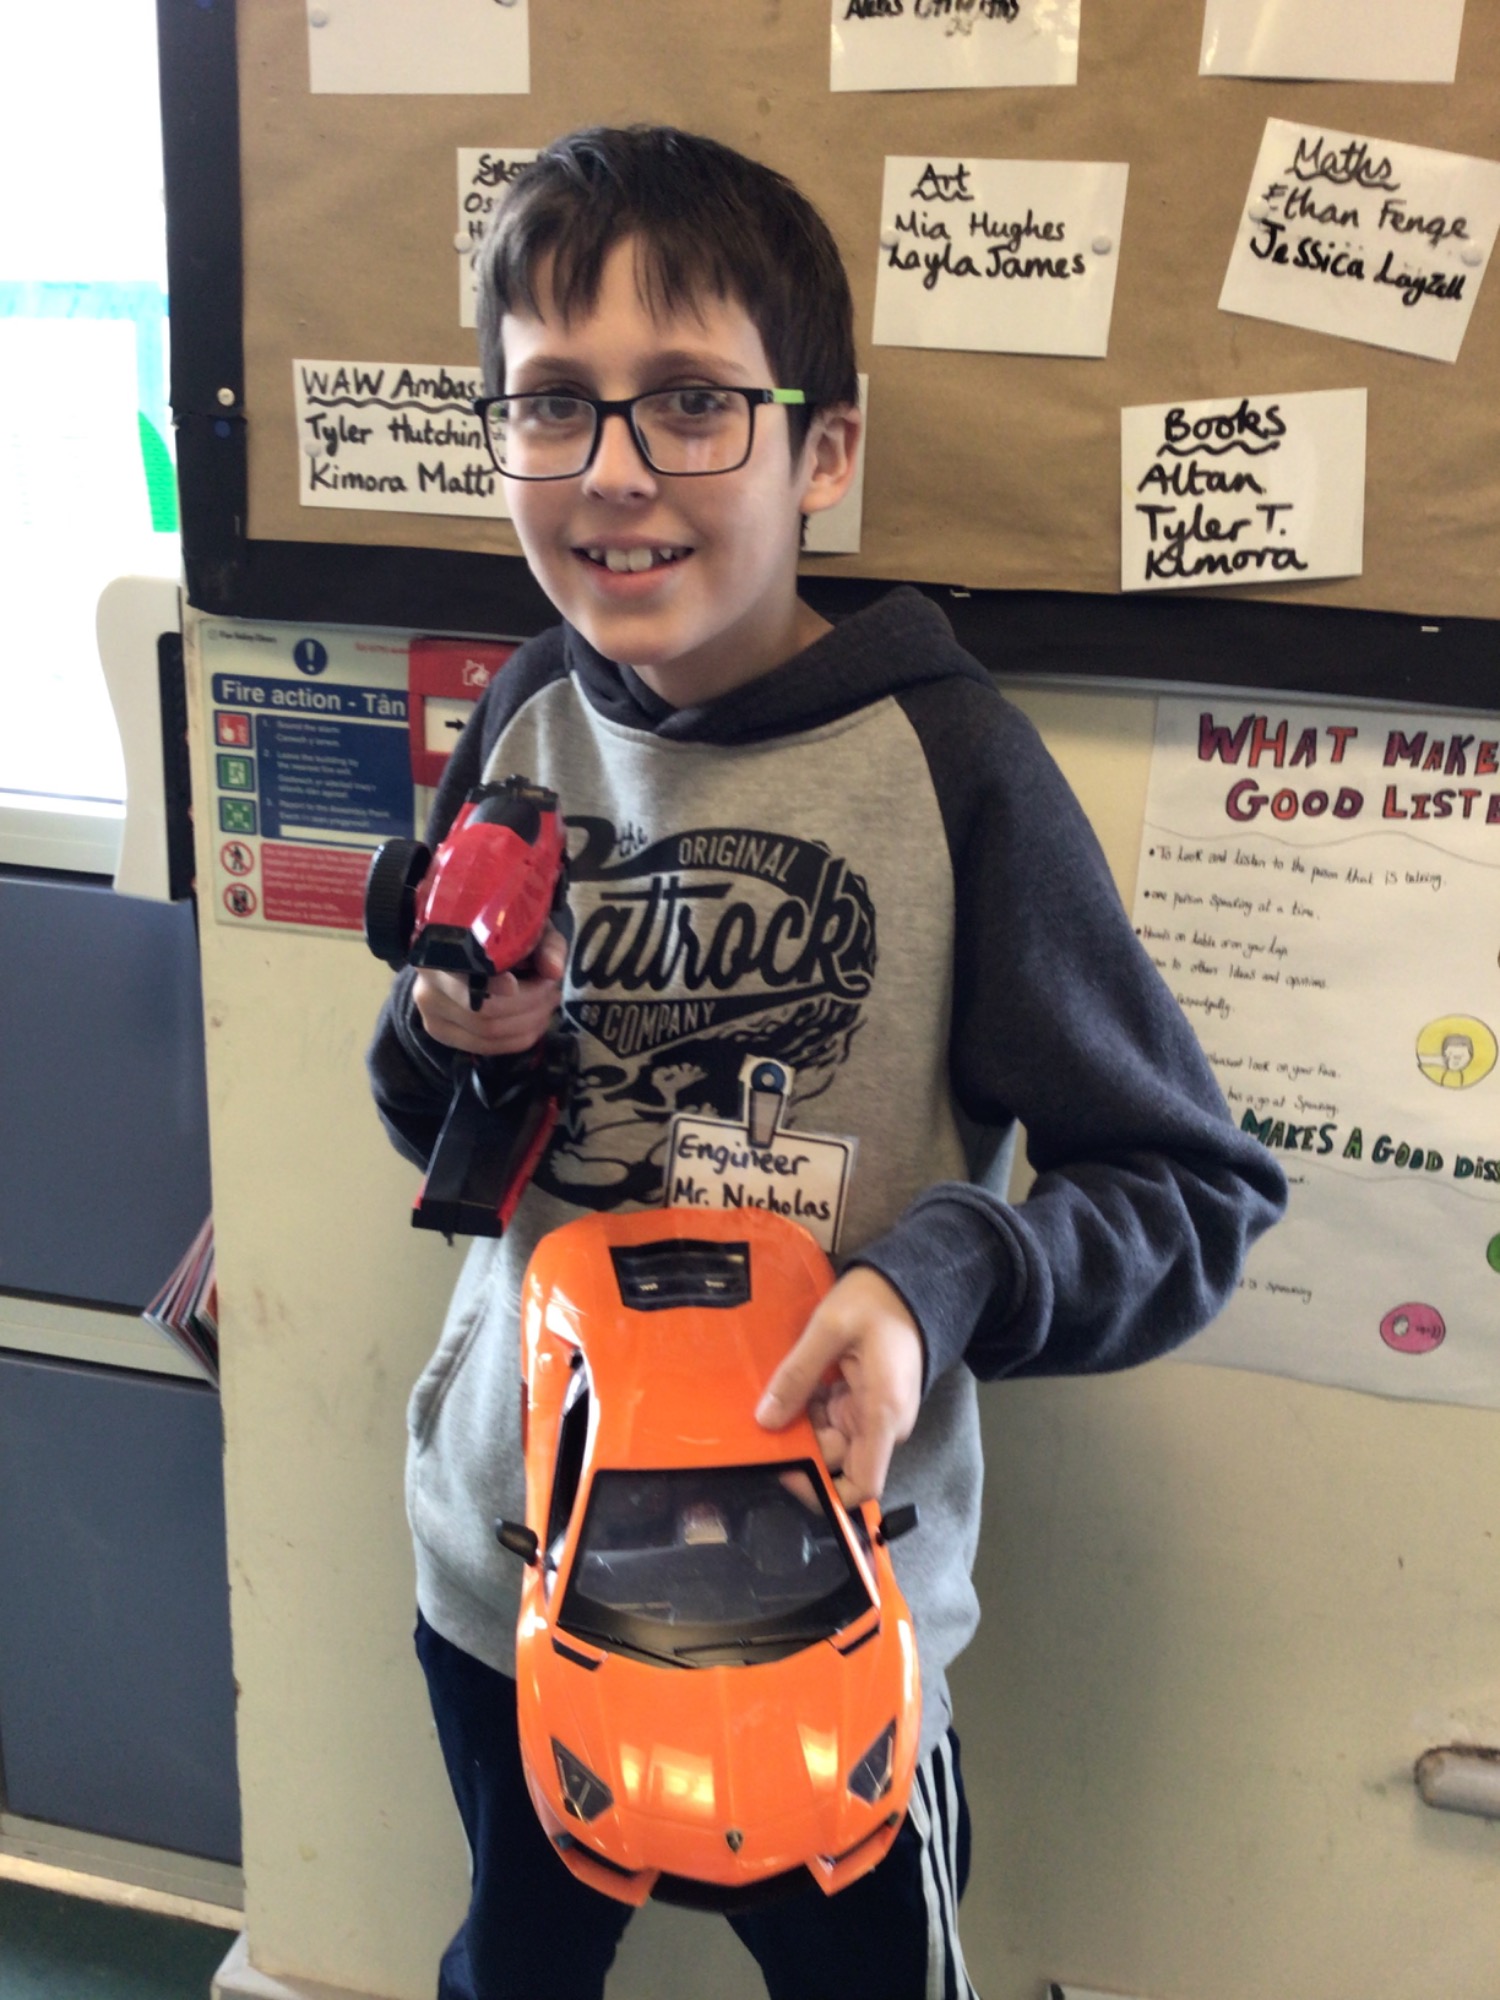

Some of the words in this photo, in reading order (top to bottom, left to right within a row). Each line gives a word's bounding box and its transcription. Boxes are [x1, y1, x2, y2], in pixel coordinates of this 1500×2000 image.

[916, 163, 971, 193] Art
[1293, 136, 1393, 181] Maths
[895, 210, 951, 241] Mia
[968, 208, 1066, 250] Hughes
[887, 242, 981, 291] Layla
[985, 245, 1086, 279] James
[301, 366, 385, 397] WAW
[390, 368, 485, 400] Ambas
[305, 411, 374, 457] Tyler
[1164, 398, 1287, 442] Books
[309, 456, 408, 492] Kimora
[1136, 460, 1267, 496] Altan
[1135, 502, 1252, 560] Tyler
[1255, 502, 1294, 536] T.
[1144, 547, 1309, 580] Kimora
[220, 678, 266, 705] Fire
[271, 687, 342, 711] action
[361, 691, 406, 716] Tân
[1197, 712, 1359, 769] WHAT
[1225, 778, 1365, 822] GOOD
[677, 834, 802, 884] ORIGINAL
[602, 1001, 716, 1054] COMPANY
[676, 1134, 811, 1176] Engineer
[1240, 1107, 1338, 1155] MAKES
[1341, 1126, 1364, 1160] A
[1371, 1133, 1444, 1172] GOOD
[672, 1177, 711, 1207] Mr.
[722, 1182, 832, 1221] Nicholas
